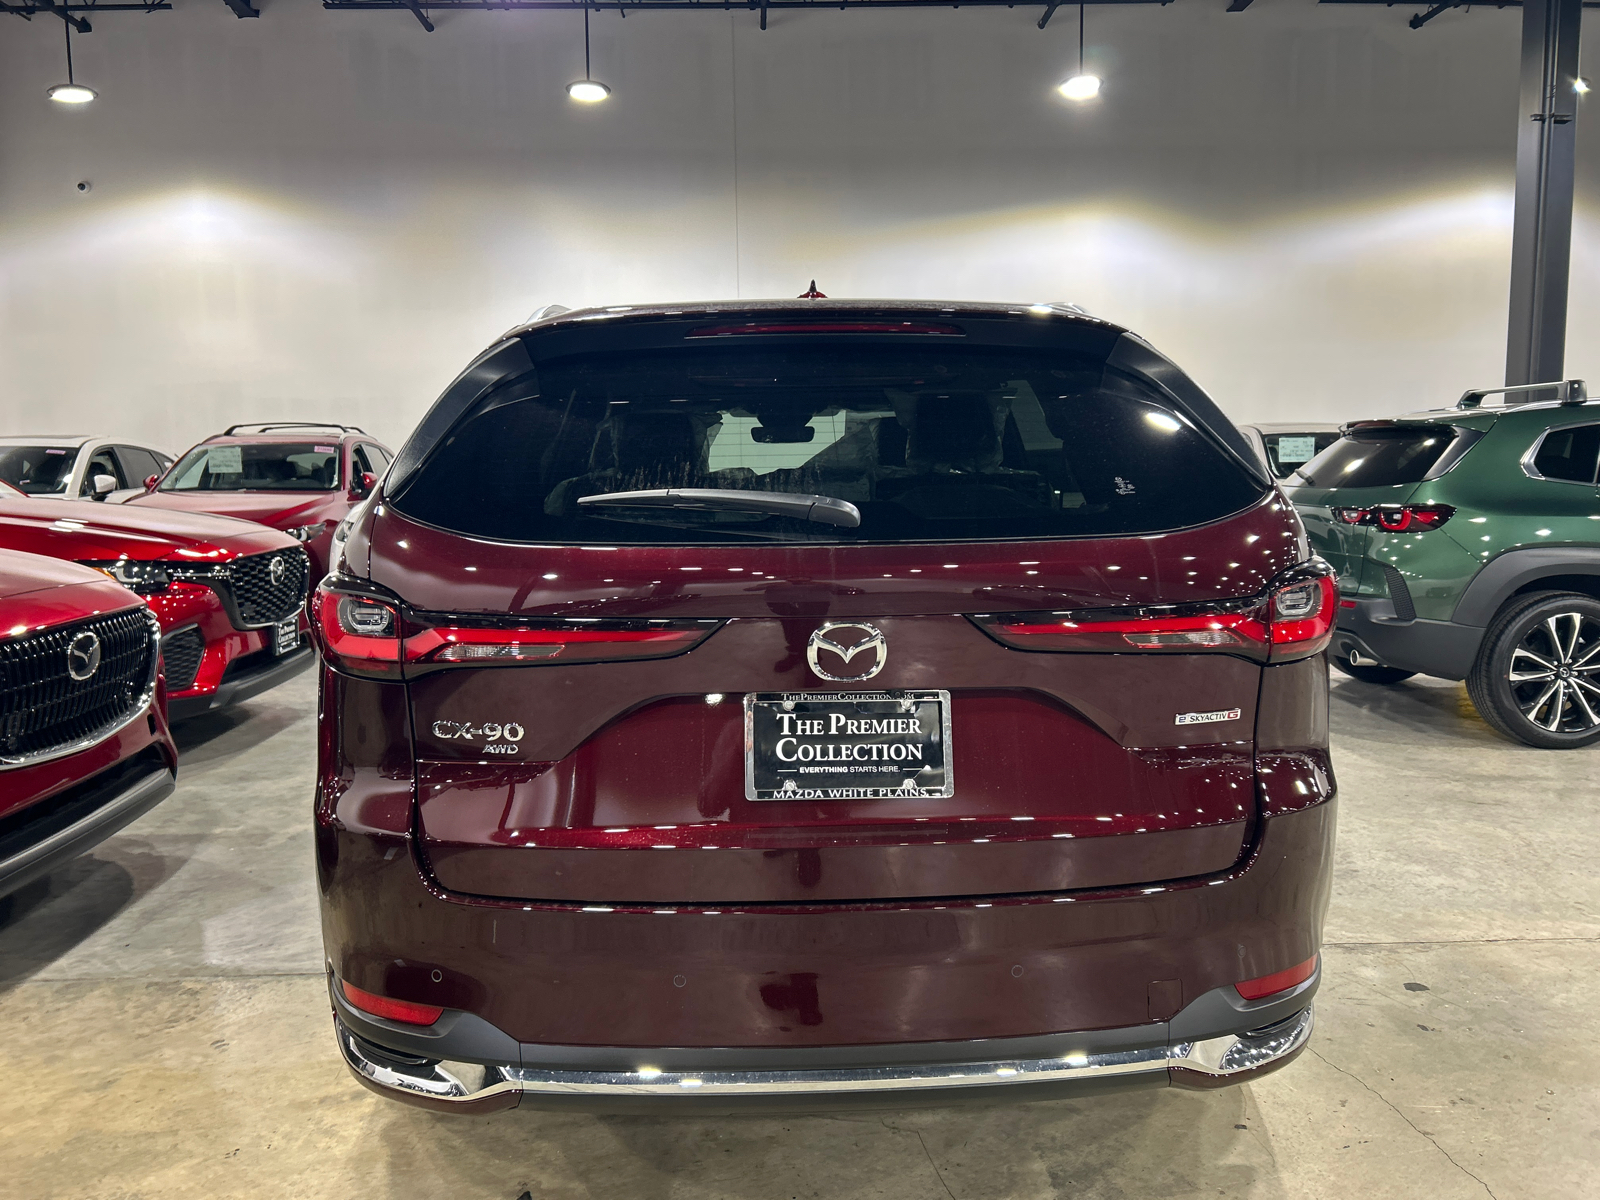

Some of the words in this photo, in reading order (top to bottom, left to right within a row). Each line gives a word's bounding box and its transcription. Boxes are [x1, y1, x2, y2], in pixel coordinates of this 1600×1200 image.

[781, 692, 915, 701] THEPREMIERCOLLECTION.M
[776, 713, 824, 735] THE
[828, 713, 922, 735] PREMIER
[431, 720, 525, 742] CX-90
[482, 744, 519, 755] AWD
[775, 737, 923, 762] COLLECTION
[799, 766, 848, 774] EVERYTHING
[849, 765, 878, 773] STARTS
[878, 765, 901, 773] HERE.
[773, 789, 824, 799] MAZDA
[828, 788, 874, 798] WHITE
[879, 788, 928, 798] PLAINS
